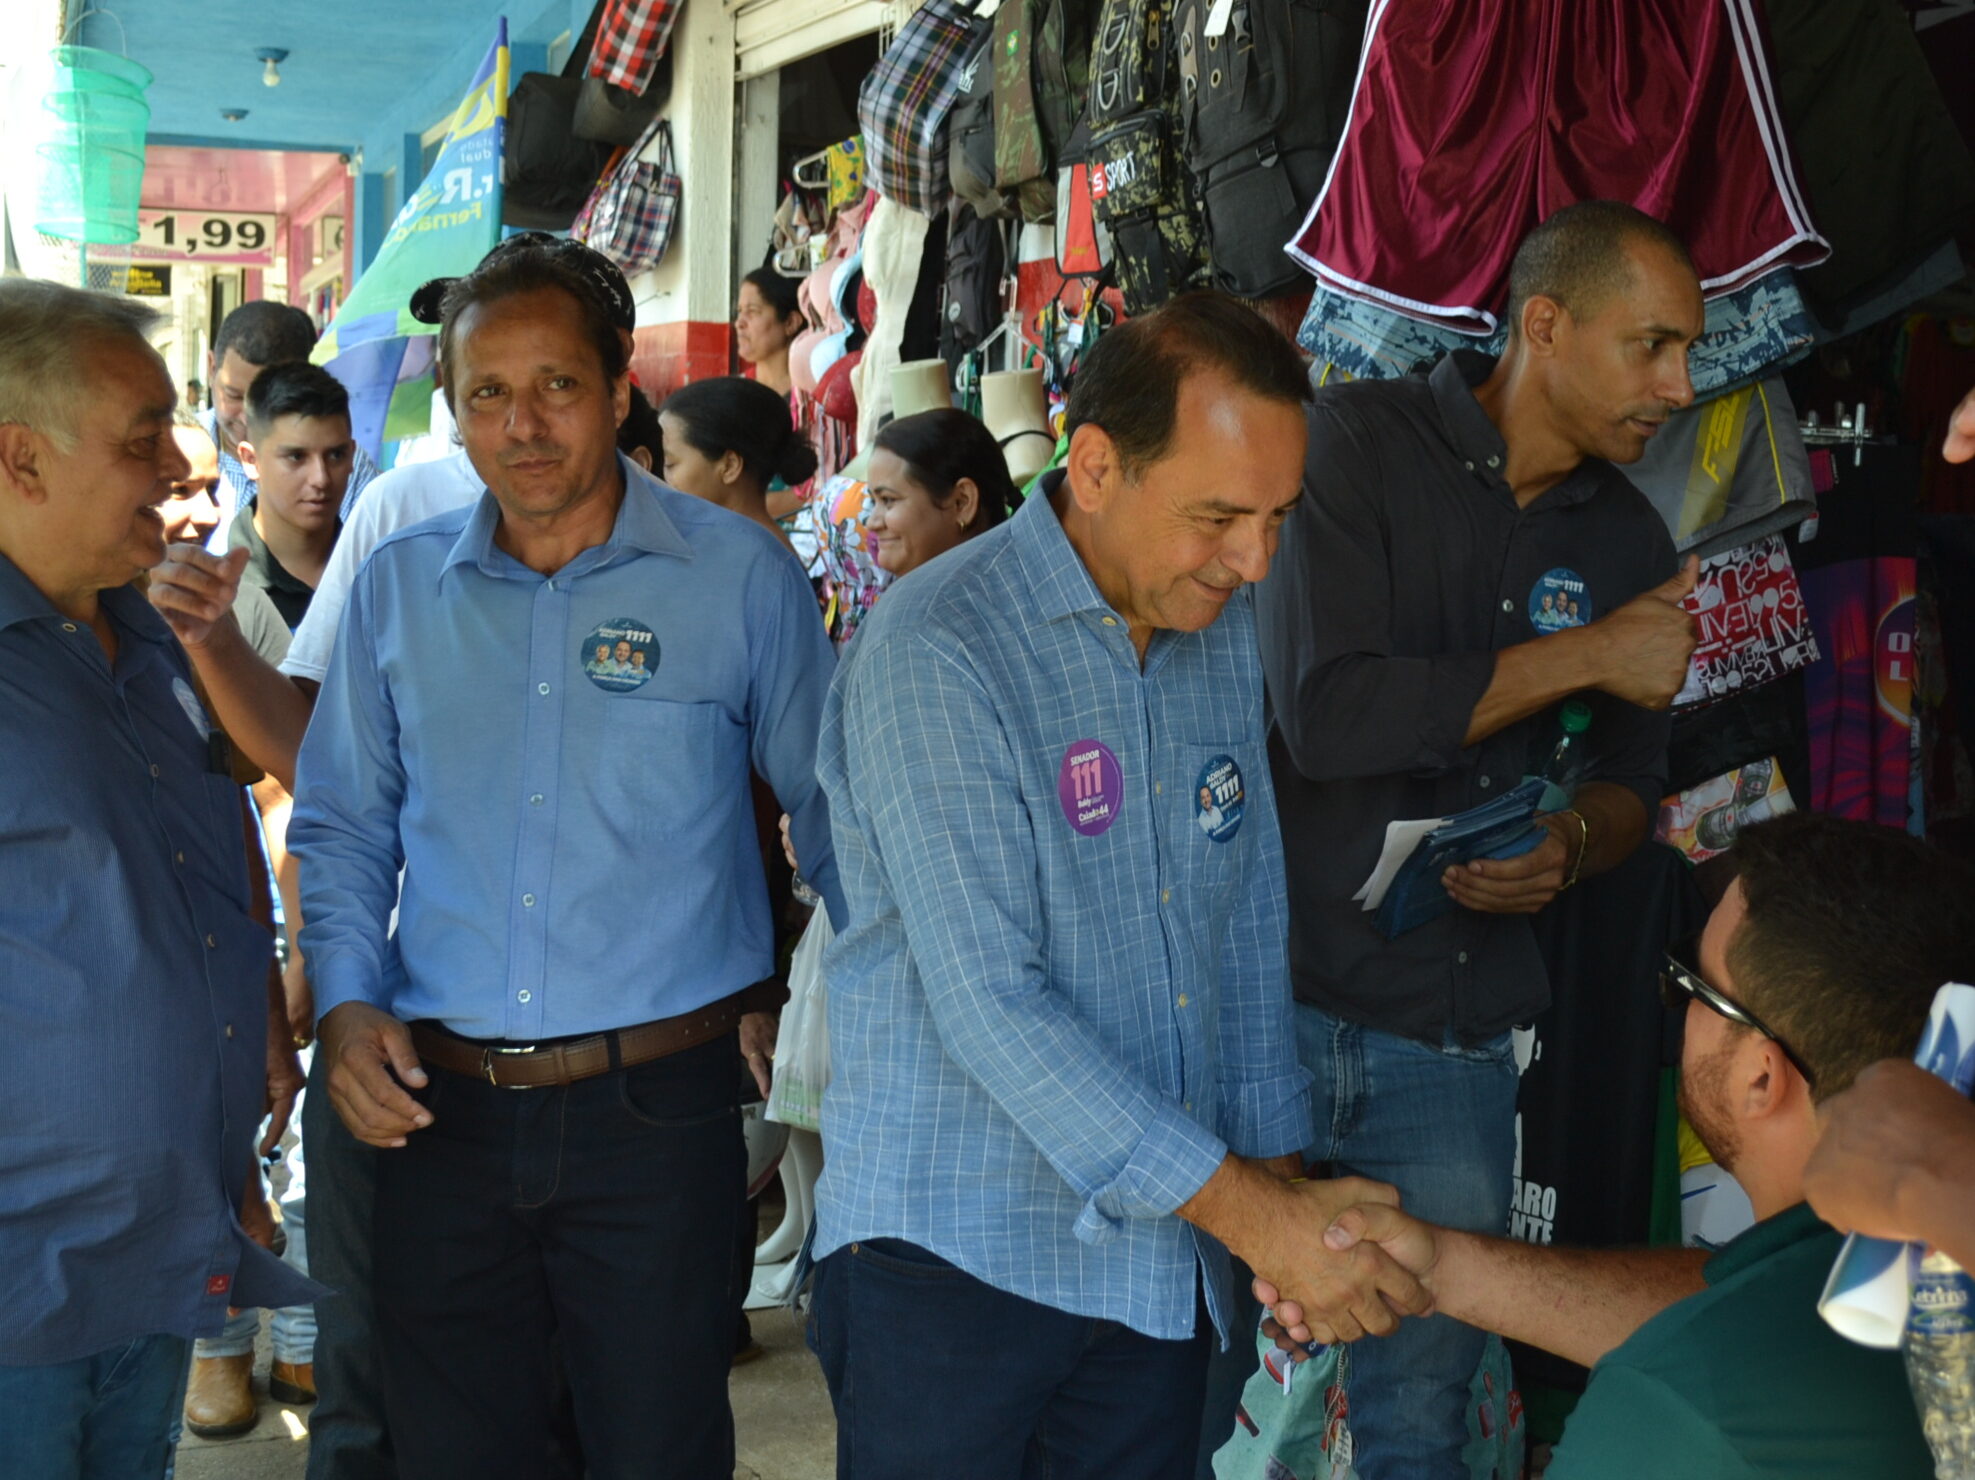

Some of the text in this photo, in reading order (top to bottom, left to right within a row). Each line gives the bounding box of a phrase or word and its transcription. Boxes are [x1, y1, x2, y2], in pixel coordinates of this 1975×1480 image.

[1104, 151, 1136, 192] SPORT
[153, 215, 266, 254] 1,99
[1070, 749, 1100, 766] SENADOR
[1071, 758, 1102, 800] 111
[1215, 774, 1240, 804] 1111
